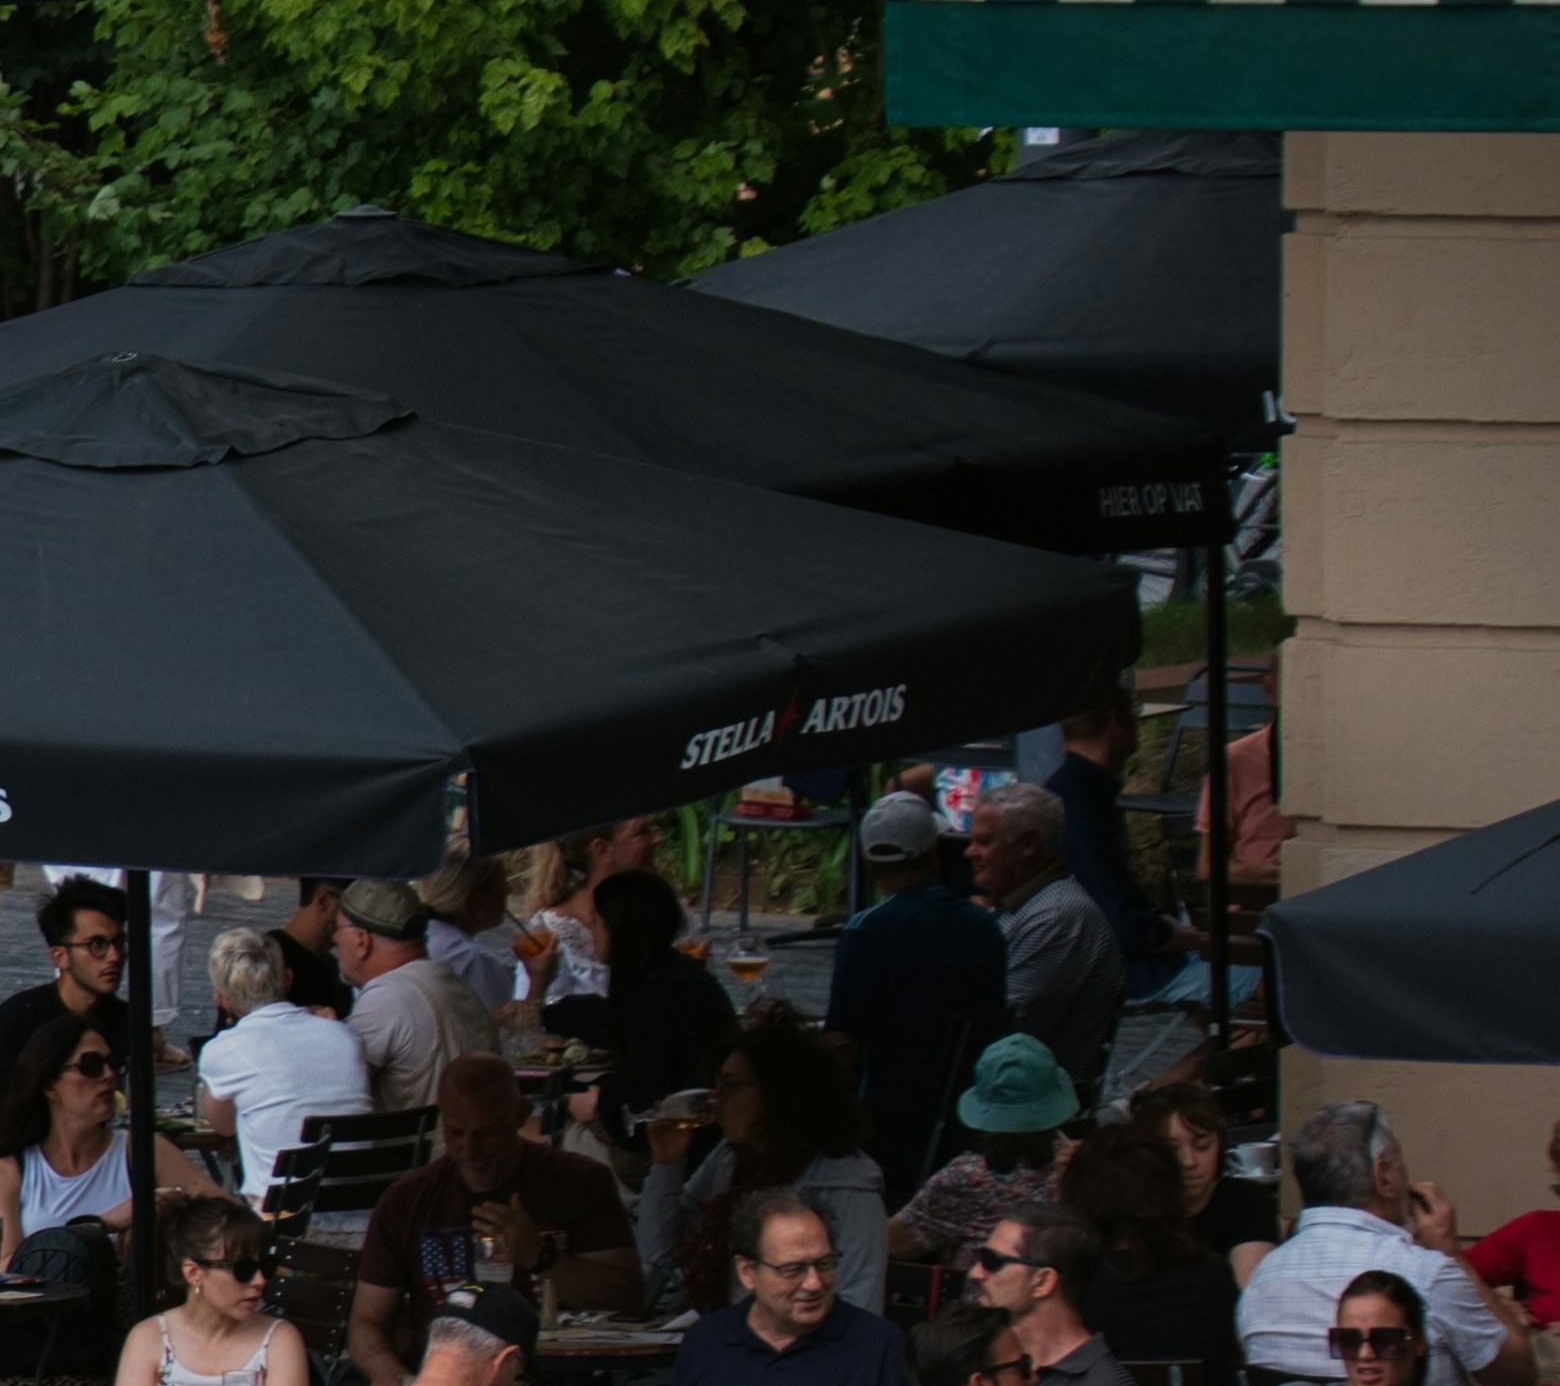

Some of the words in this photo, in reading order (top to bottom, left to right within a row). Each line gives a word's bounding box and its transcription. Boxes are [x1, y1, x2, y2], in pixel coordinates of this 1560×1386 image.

[1098, 484, 1142, 517] HIER
[1143, 483, 1168, 514] OP
[1170, 481, 1203, 513] VAT
[680, 709, 776, 770] STELLA
[800, 683, 907, 734] ARTOIS
